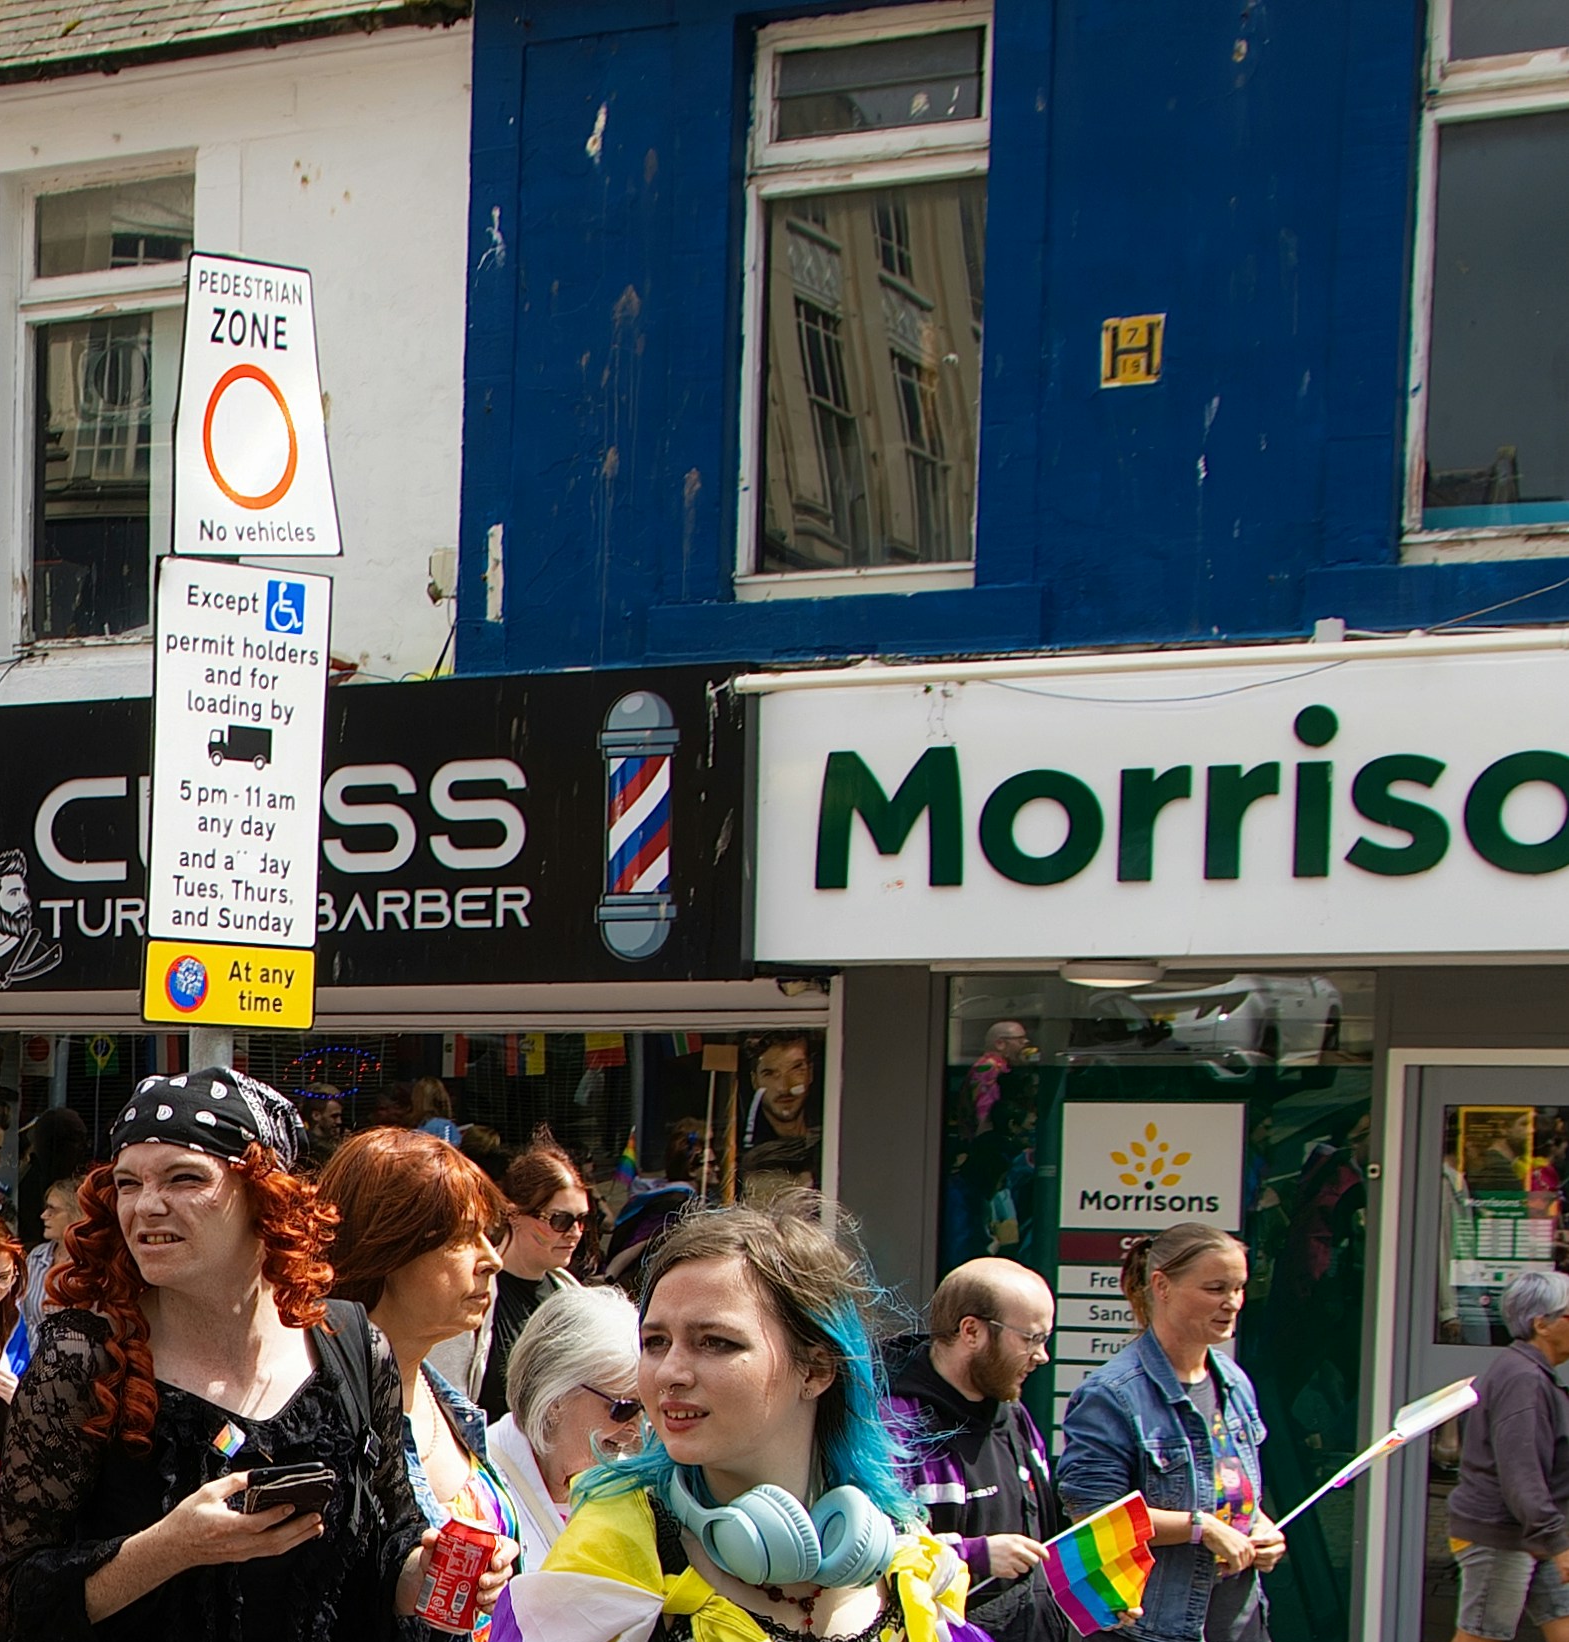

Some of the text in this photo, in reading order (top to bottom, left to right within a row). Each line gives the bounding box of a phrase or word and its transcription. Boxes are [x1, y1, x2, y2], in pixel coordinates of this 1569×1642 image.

[198, 269, 303, 306] PEDESTRIAN
[210, 307, 288, 351] ZONE
[1126, 327, 1140, 344] 7
[1103, 320, 1161, 380] H
[199, 519, 316, 542] No vehicles
[187, 584, 259, 615] Except
[166, 633, 319, 666] permit holders
[204, 665, 279, 690] and for
[187, 689, 295, 725] loading by
[180, 779, 192, 801] 5
[197, 785, 228, 807] pm
[245, 785, 261, 807] 11
[267, 792, 296, 811] am
[34, 758, 527, 882] CSS
[198, 814, 276, 841] any day
[179, 848, 216, 869] and
[172, 874, 224, 901] Tues,
[171, 906, 294, 938] and Sunday
[228, 960, 295, 988] At any
[238, 991, 283, 1013] time
[1079, 1181, 1220, 1213] Morrisons
